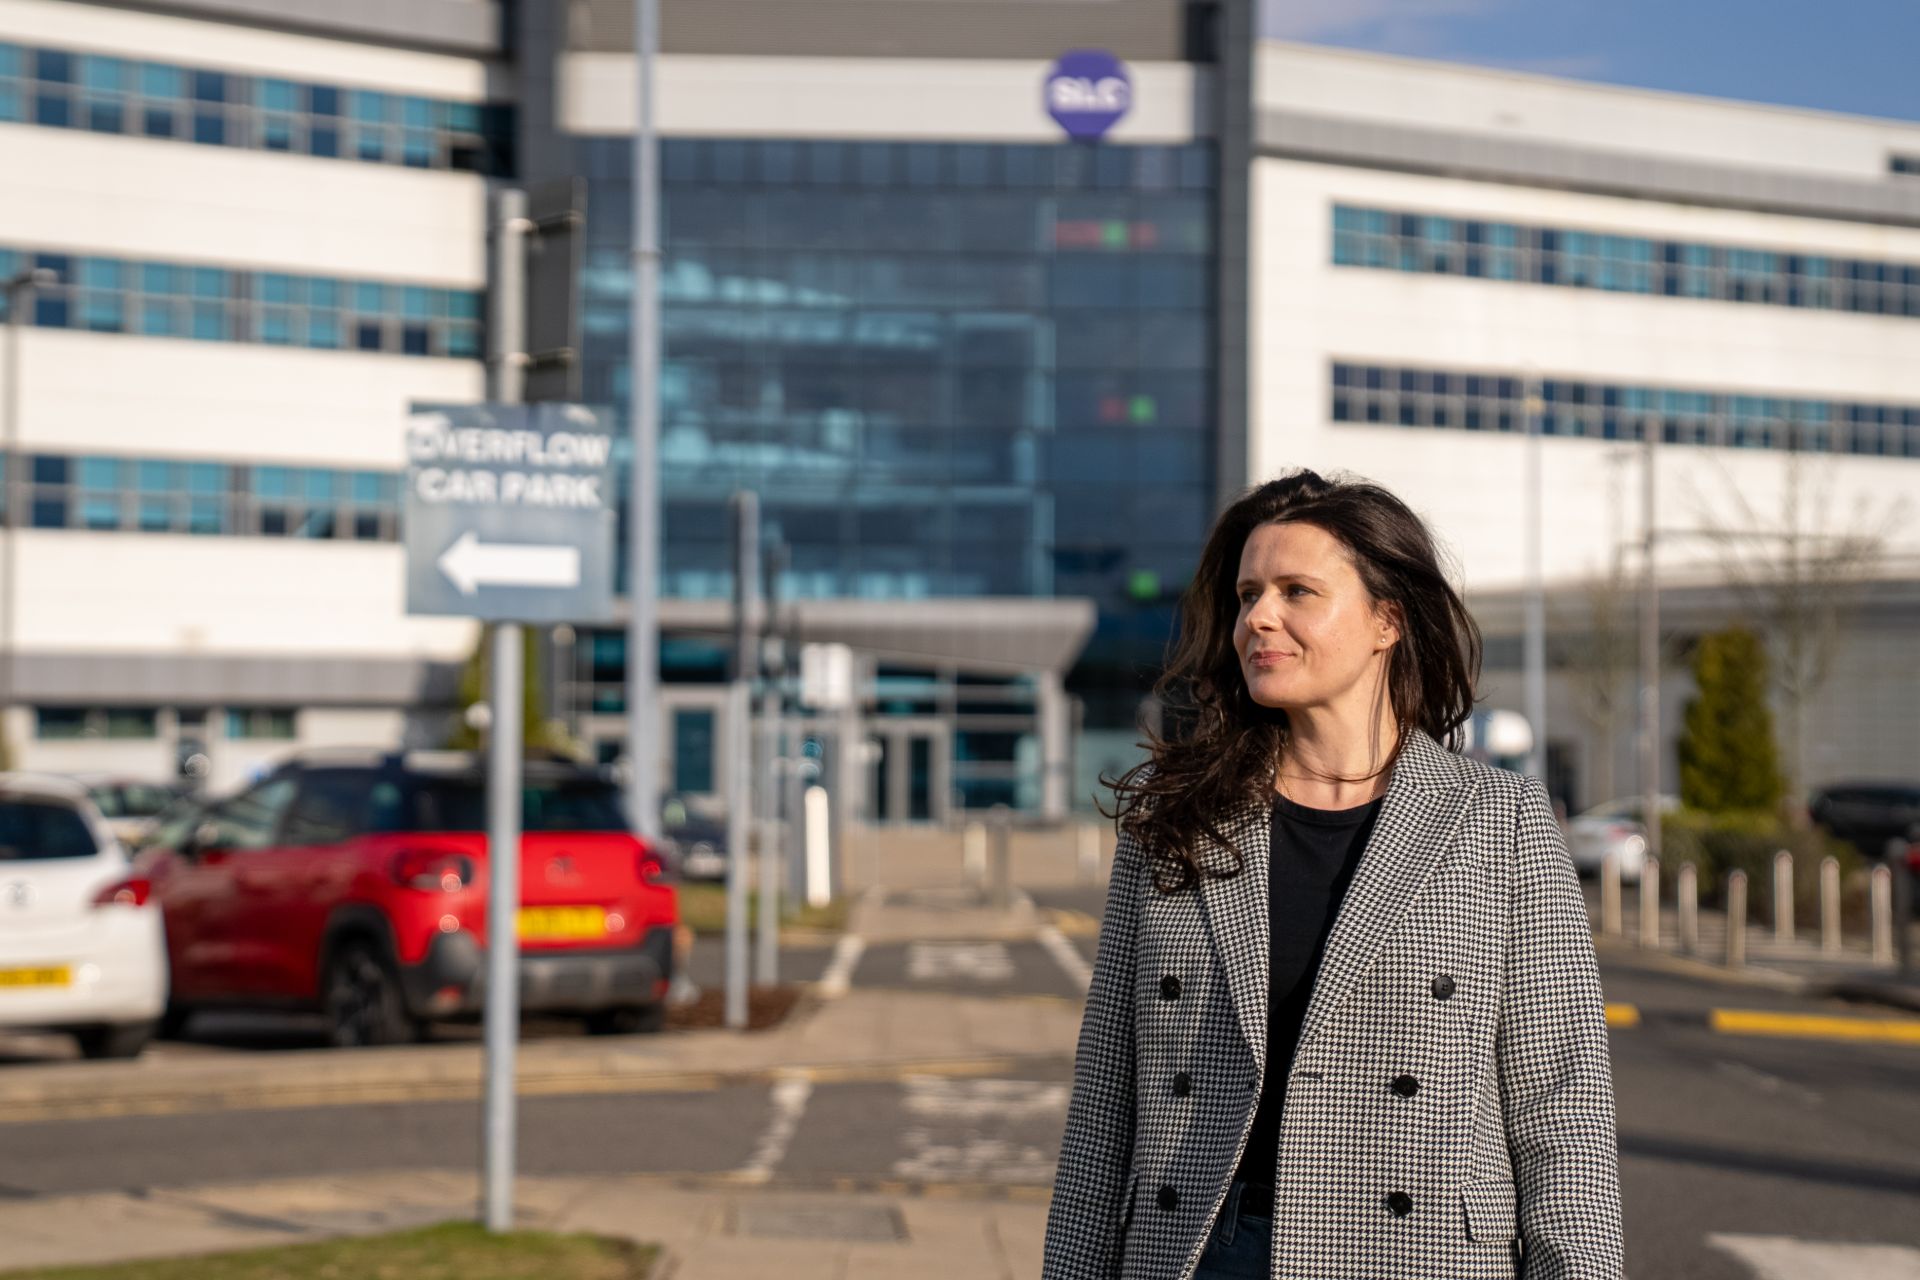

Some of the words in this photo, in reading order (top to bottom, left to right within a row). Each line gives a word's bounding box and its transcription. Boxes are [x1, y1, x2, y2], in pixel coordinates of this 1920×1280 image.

[408, 424, 611, 466] OVERFLOW
[416, 468, 498, 504] CAR
[501, 472, 600, 508] PARK
